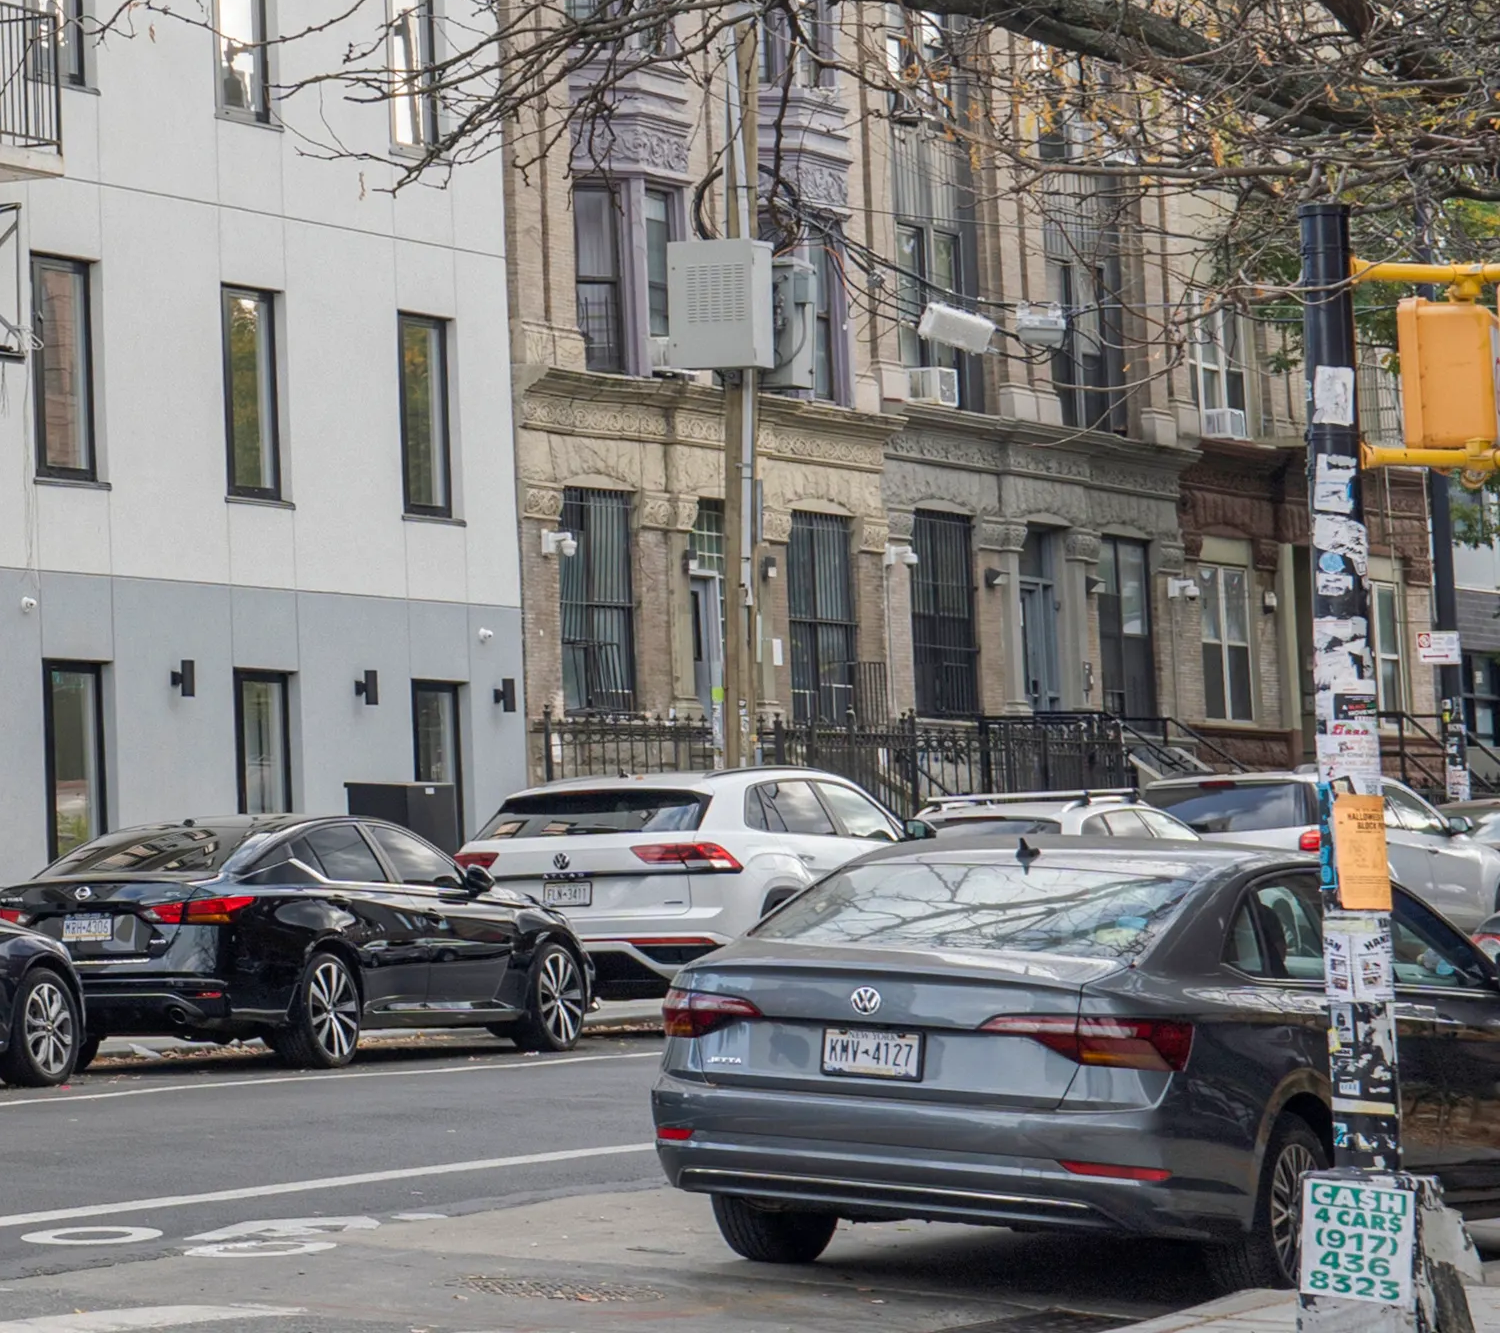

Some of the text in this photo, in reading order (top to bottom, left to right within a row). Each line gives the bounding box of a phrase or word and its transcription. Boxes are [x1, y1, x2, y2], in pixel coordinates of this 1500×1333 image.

[1357, 822, 1377, 830] BLOCK
[848, 1032, 897, 1041] NEW YORK
[1315, 1207, 1331, 1223] 4
[1315, 1227, 1399, 1256] (917)
[1319, 1250, 1391, 1277] 436
[1309, 1270, 1400, 1300] 8323
